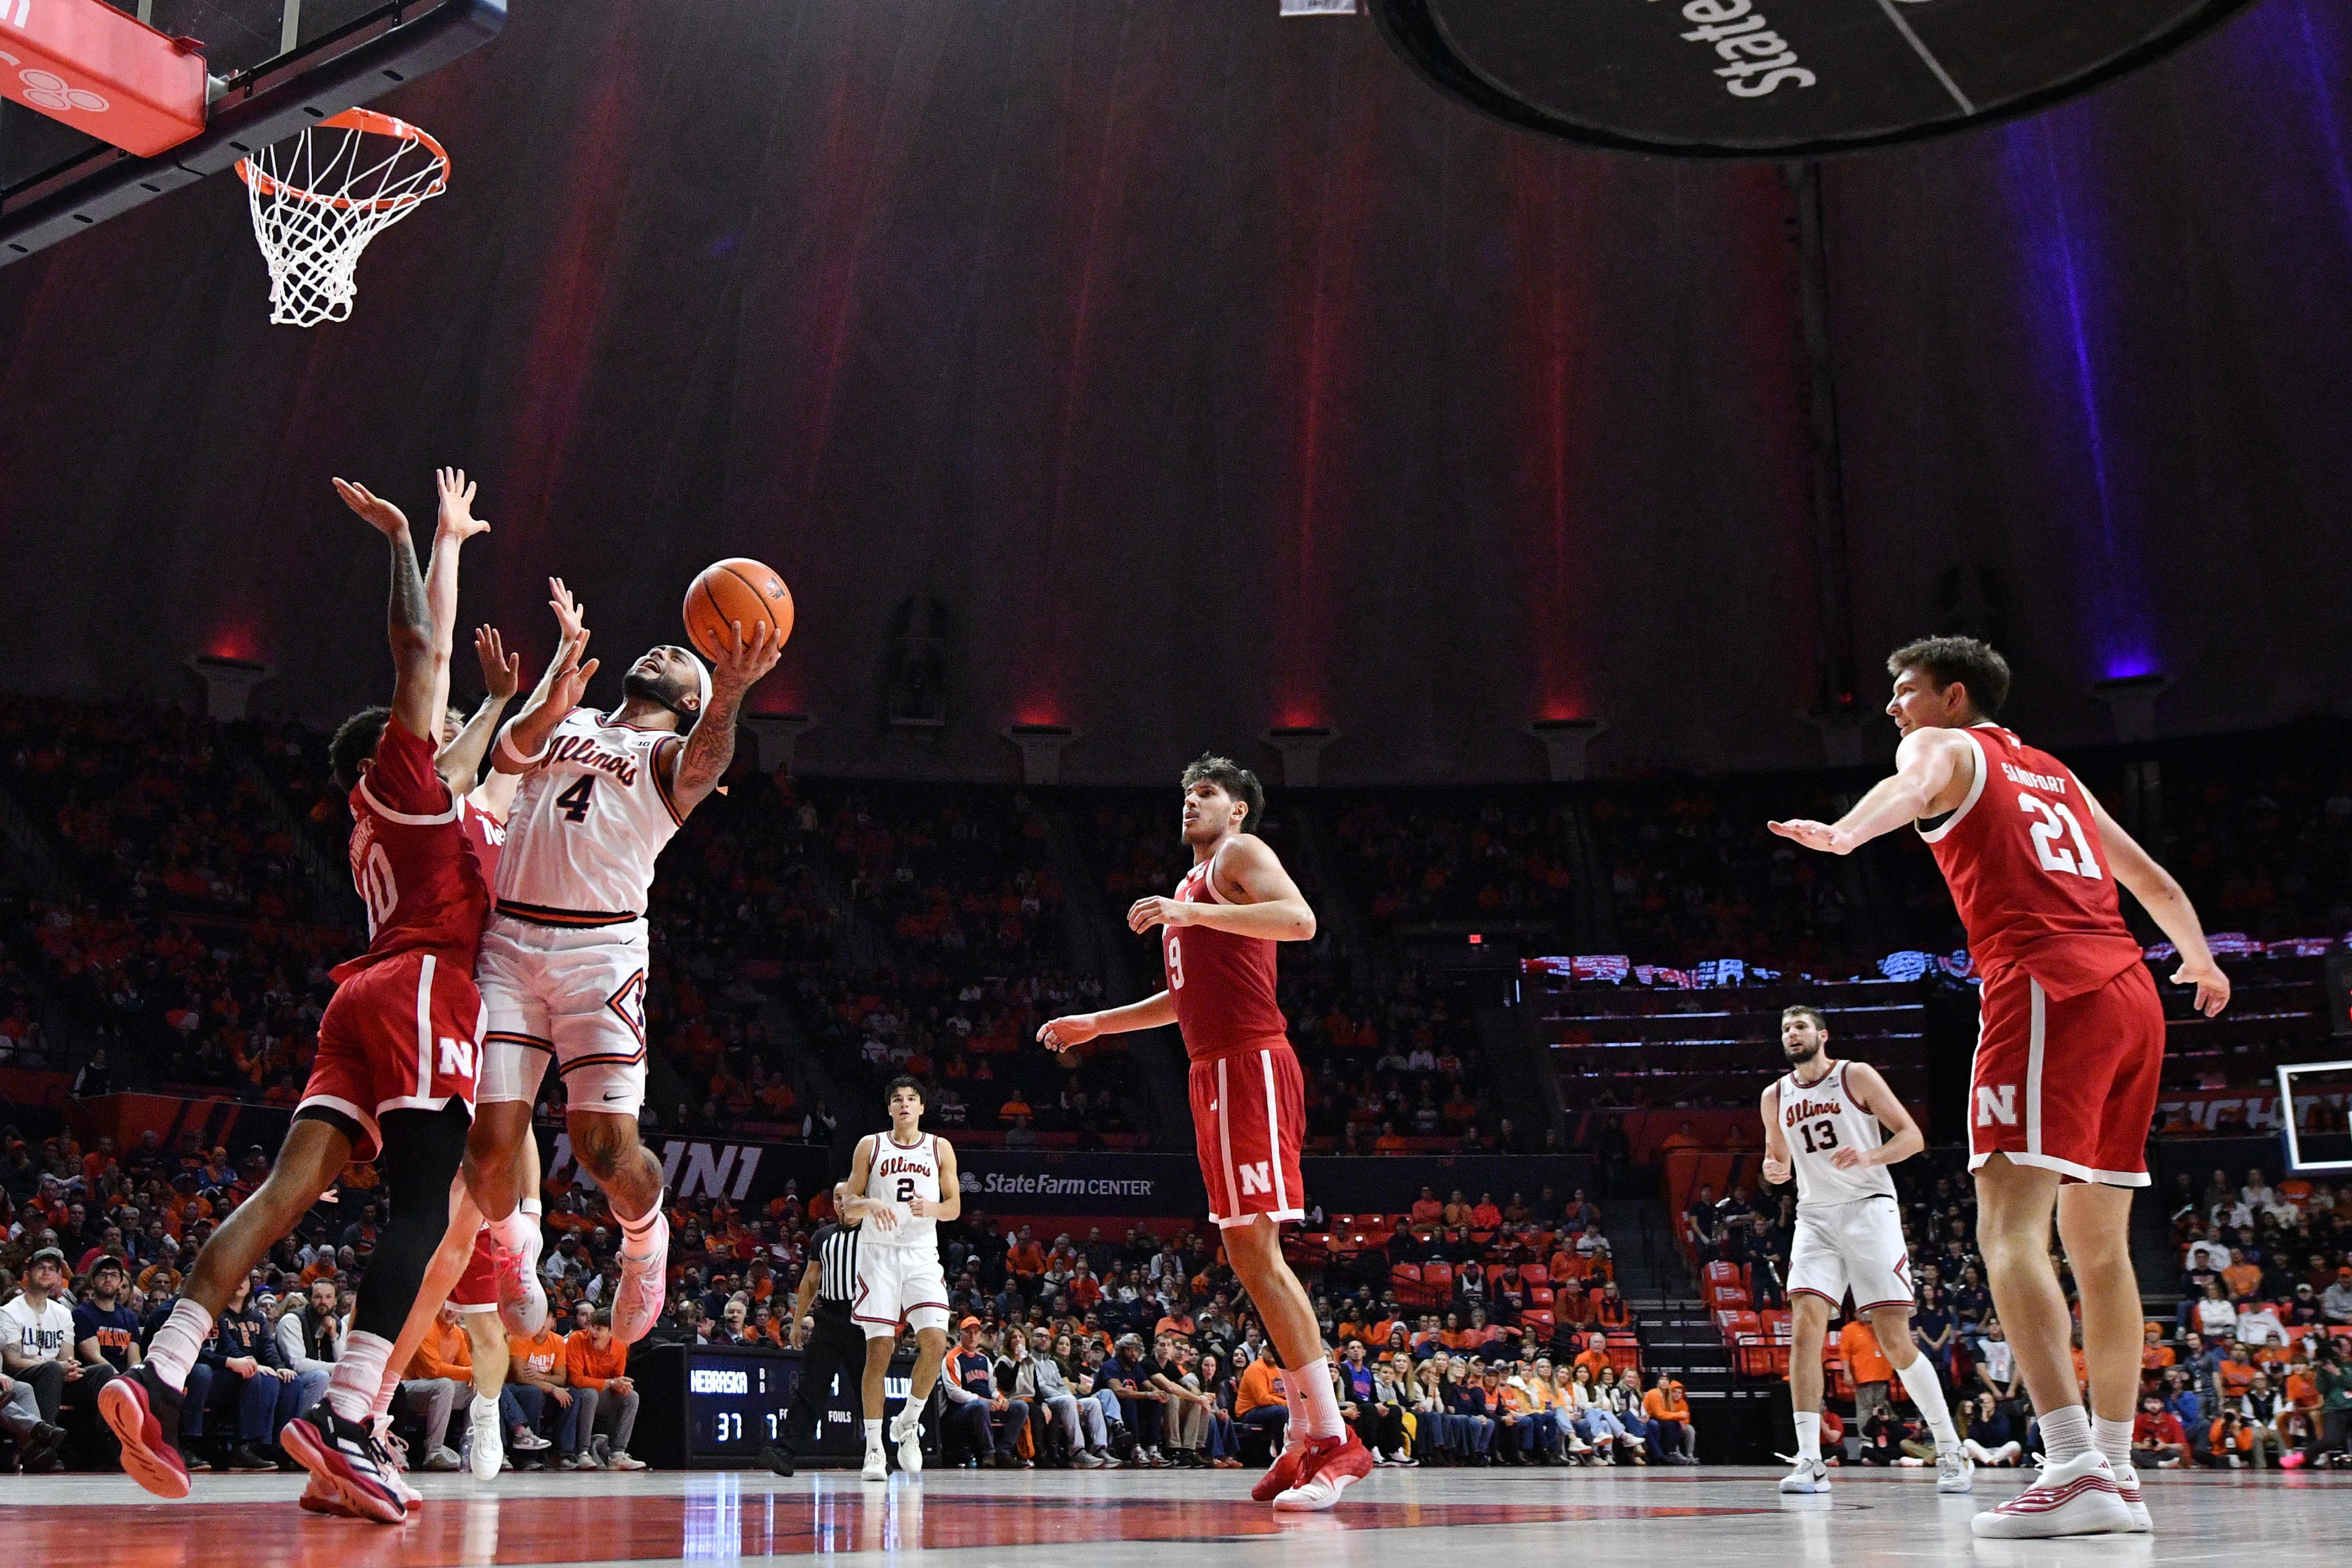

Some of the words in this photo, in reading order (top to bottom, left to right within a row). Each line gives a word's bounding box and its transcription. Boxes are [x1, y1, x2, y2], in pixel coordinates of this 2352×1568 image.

[1679, 0, 1816, 97] State
[541, 735, 637, 787] Illinois
[2001, 762, 2066, 795] SANDFORT
[556, 773, 596, 824] 4
[2018, 792, 2103, 880] 21
[1168, 936, 1185, 990] 9
[438, 1036, 473, 1079] N
[1786, 1098, 1841, 1127] Illinois
[1977, 1084, 2018, 1128] N
[1800, 1119, 1838, 1154] 13
[547, 1133, 762, 1200] IINI
[880, 1156, 931, 1177] Illinois
[1239, 1160, 1272, 1195] N
[896, 1178, 914, 1202] 2
[1088, 1179, 1151, 1196] CENTER
[690, 1369, 748, 1394] NEBRASKA
[759, 1367, 766, 1380] B
[759, 1381, 766, 1394] B
[717, 1413, 742, 1442] 37
[766, 1413, 777, 1441] 7
[828, 1410, 852, 1423] FOULS
